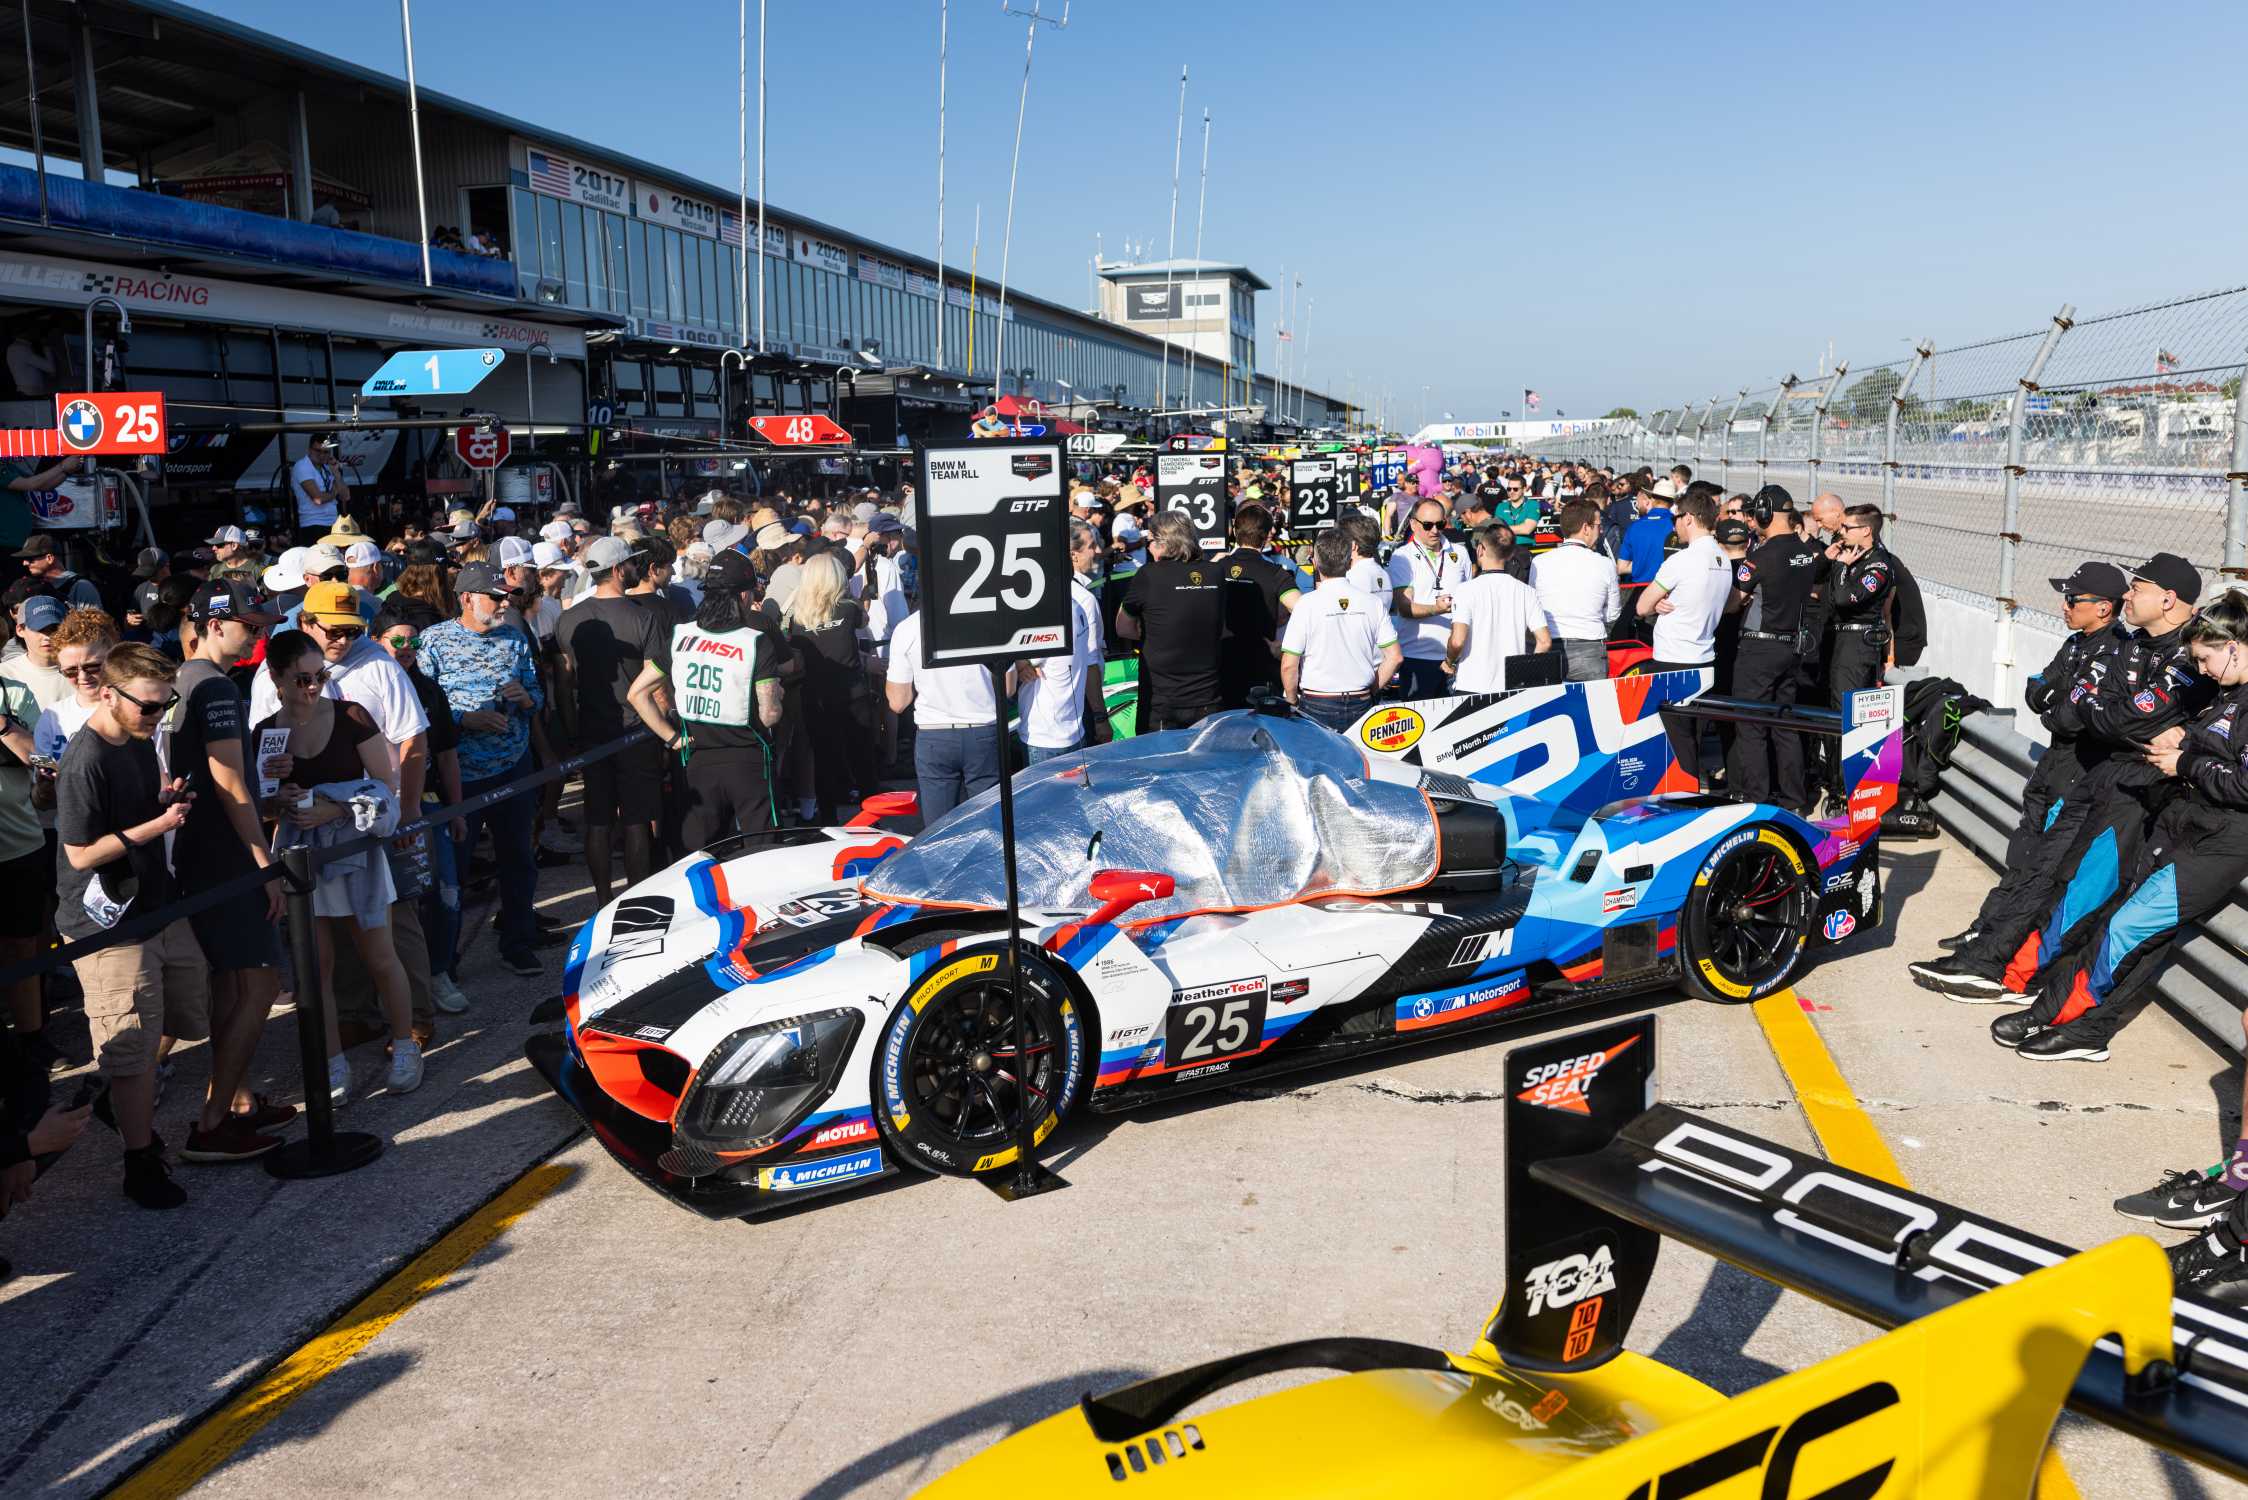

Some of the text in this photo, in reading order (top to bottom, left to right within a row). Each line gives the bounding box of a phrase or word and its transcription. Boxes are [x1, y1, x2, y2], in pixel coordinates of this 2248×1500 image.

[574, 166, 625, 198] 2017
[582, 189, 620, 210] Cadillac
[671, 195, 714, 223] 2018
[749, 220, 784, 244] 219
[816, 241, 846, 263] 2020
[114, 276, 209, 305] RACING
[498, 326, 550, 344] RACING
[424, 354, 440, 390] 1
[66, 402, 97, 417] BMW
[587, 405, 612, 425] 10
[115, 405, 159, 442] 25
[786, 418, 814, 442] 48
[1454, 426, 1491, 437] Mobil
[1551, 423, 1589, 435] Mobil
[1071, 437, 1094, 452] 40
[1172, 440, 1185, 450] 45
[930, 460, 967, 471] BMW M
[931, 470, 980, 480] TEAM RLL
[1010, 499, 1050, 512] GTP
[1167, 493, 1217, 531] 63
[1298, 488, 1330, 516] 23
[948, 532, 1046, 615] 25
[696, 639, 744, 661] IMSA
[1031, 633, 1059, 643] IMSA
[685, 662, 724, 693] 205
[685, 694, 721, 719] VIDEO
[1868, 709, 1889, 718] BOSCH
[263, 735, 287, 747] FAN
[1370, 717, 1415, 742] PENNZOIL
[261, 745, 285, 754] GUIDE
[1435, 726, 1509, 763] BMW of North America
[1709, 830, 1754, 866] MICHELIN
[1605, 894, 1636, 907] CHAMPION
[1171, 980, 1264, 1004] WeatherTech
[1469, 977, 1521, 1004] Motorsport
[888, 957, 993, 1100] MICHELIN PILOT SPORT M
[1123, 1025, 1149, 1037] GTP
[1181, 999, 1251, 1060] 25
[1060, 1029, 1080, 1110] MICHELIN
[1184, 1061, 1231, 1078] FAST TRACK
[1522, 1051, 1606, 1088] SPEED
[1530, 1072, 1599, 1106] SEAT
[815, 1122, 866, 1144] MOTUL
[916, 1142, 931, 1155] OK
[795, 1157, 872, 1182] MICHELIN
[1525, 1259, 1615, 1301] TRACK OUT
[1576, 1303, 1596, 1328] 10
[1569, 1331, 1589, 1358] 10
